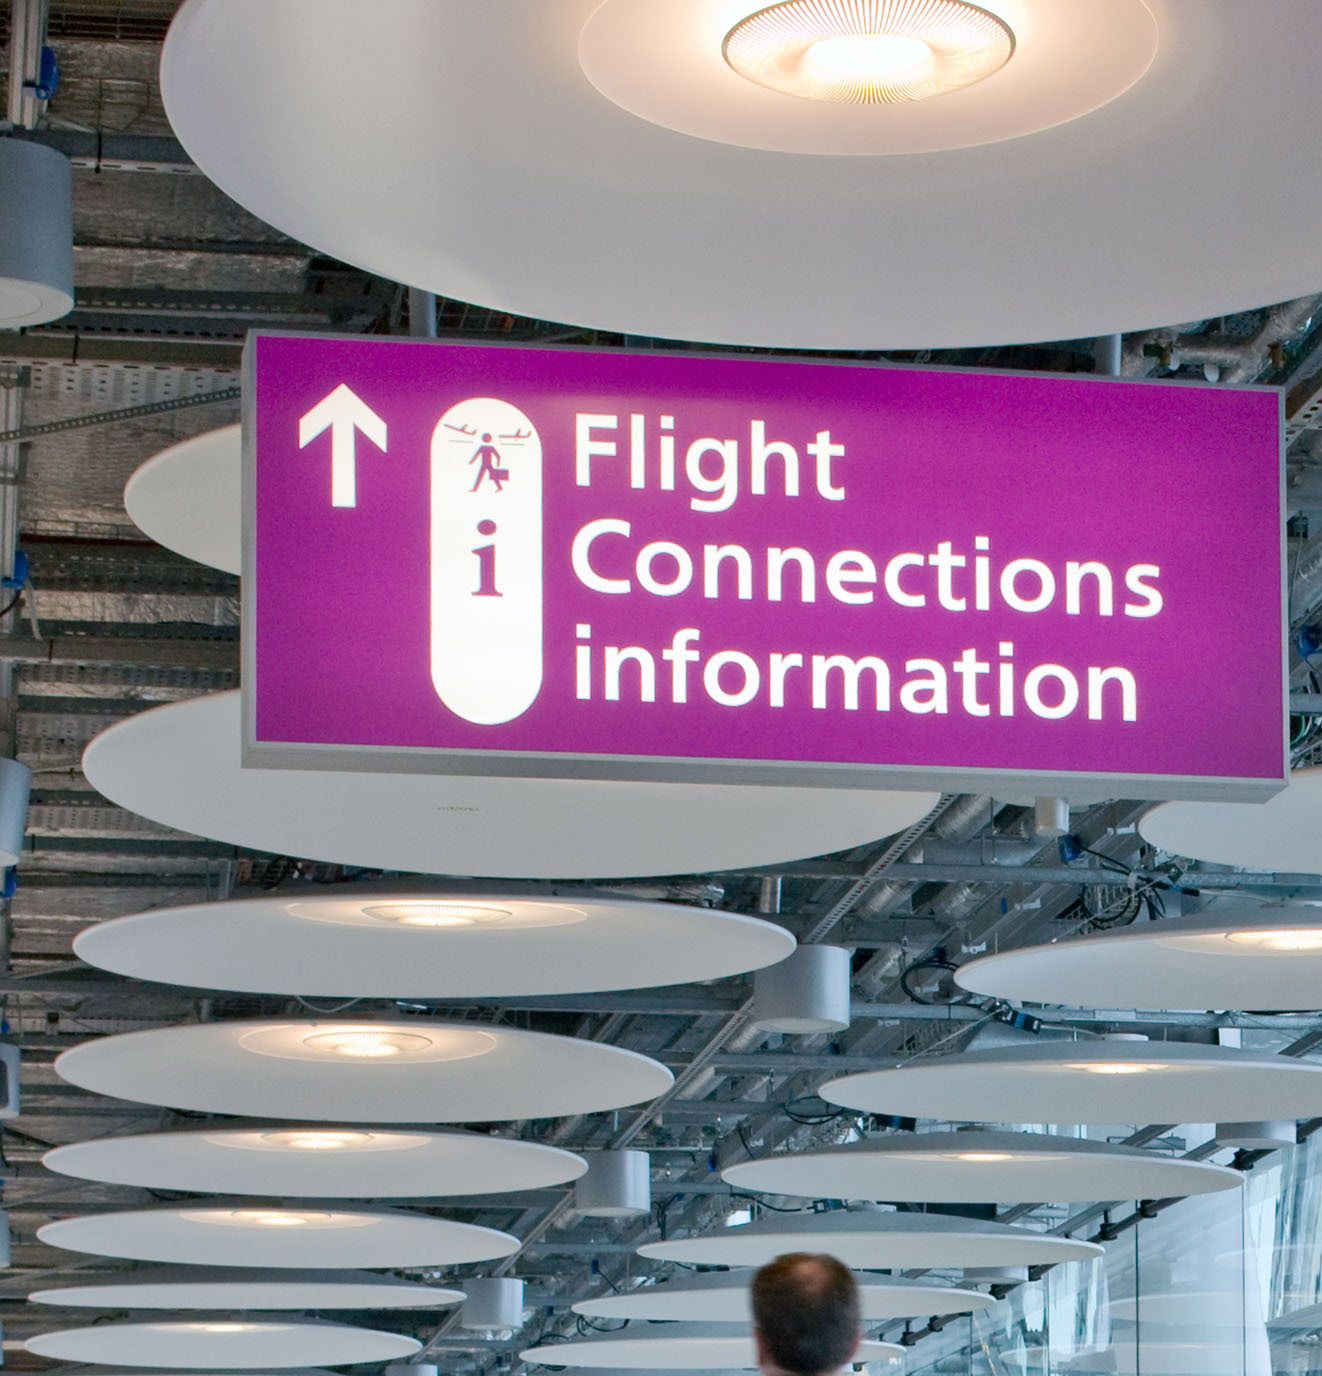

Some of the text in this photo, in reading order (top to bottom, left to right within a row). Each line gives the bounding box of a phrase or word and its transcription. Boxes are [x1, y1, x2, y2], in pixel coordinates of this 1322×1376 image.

[574, 412, 846, 512] Flight
[571, 519, 1164, 617] Connections
[573, 624, 1139, 721] information
